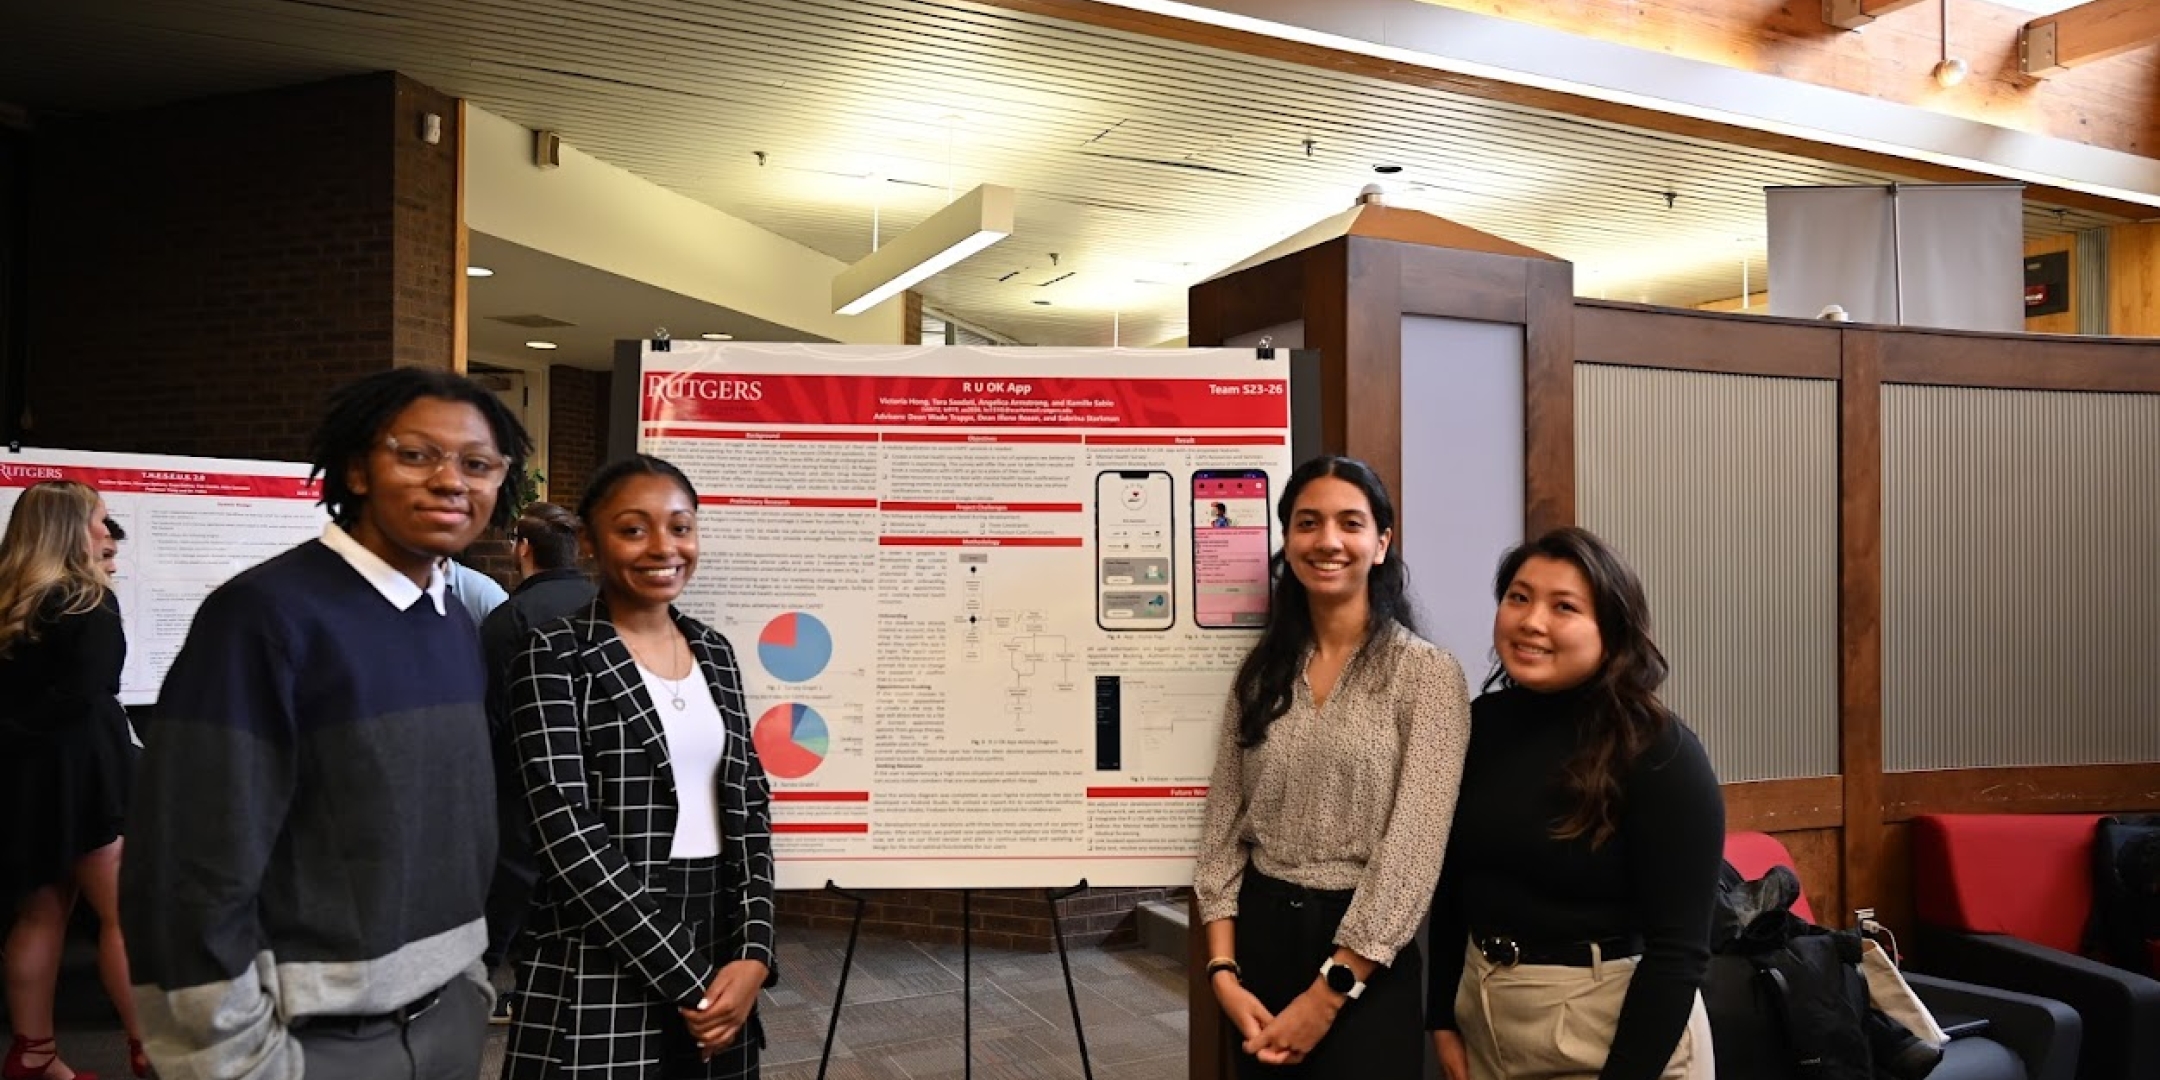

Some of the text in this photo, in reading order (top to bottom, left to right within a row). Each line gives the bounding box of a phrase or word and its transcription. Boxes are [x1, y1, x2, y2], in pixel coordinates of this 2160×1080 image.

[647, 375, 763, 406] RUTGERS
[963, 382, 1032, 396] R U OK App
[1209, 384, 1283, 394] Team S23-26
[1170, 788, 1191, 796] Future
